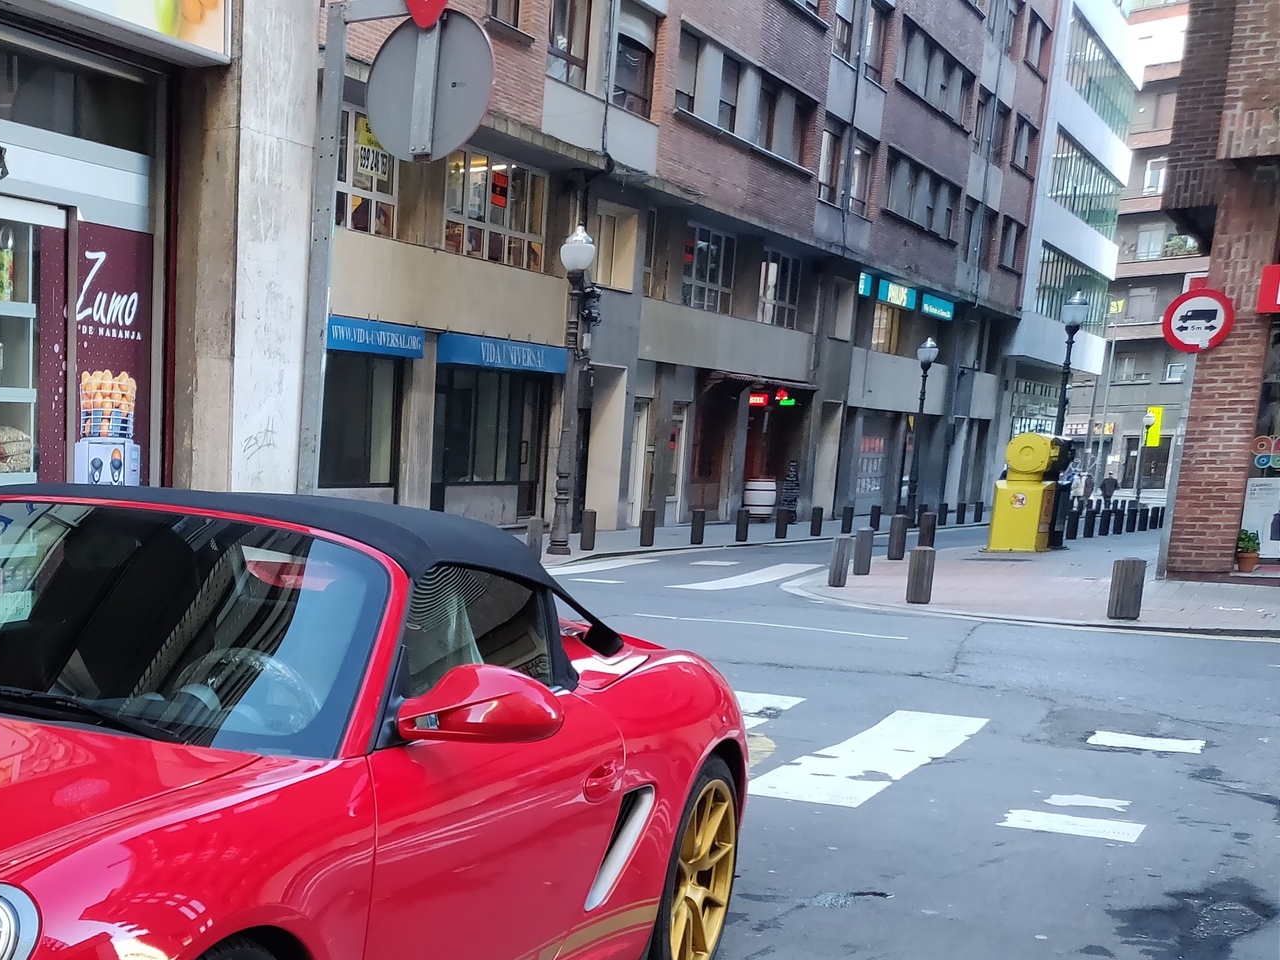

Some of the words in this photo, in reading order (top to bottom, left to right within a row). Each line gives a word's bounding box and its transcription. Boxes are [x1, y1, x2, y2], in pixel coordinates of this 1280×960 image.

[76, 250, 139, 327] Zumo
[81, 324, 95, 336] DE
[98, 326, 142, 341] NARANJA
[480, 341, 501, 365] VIDA
